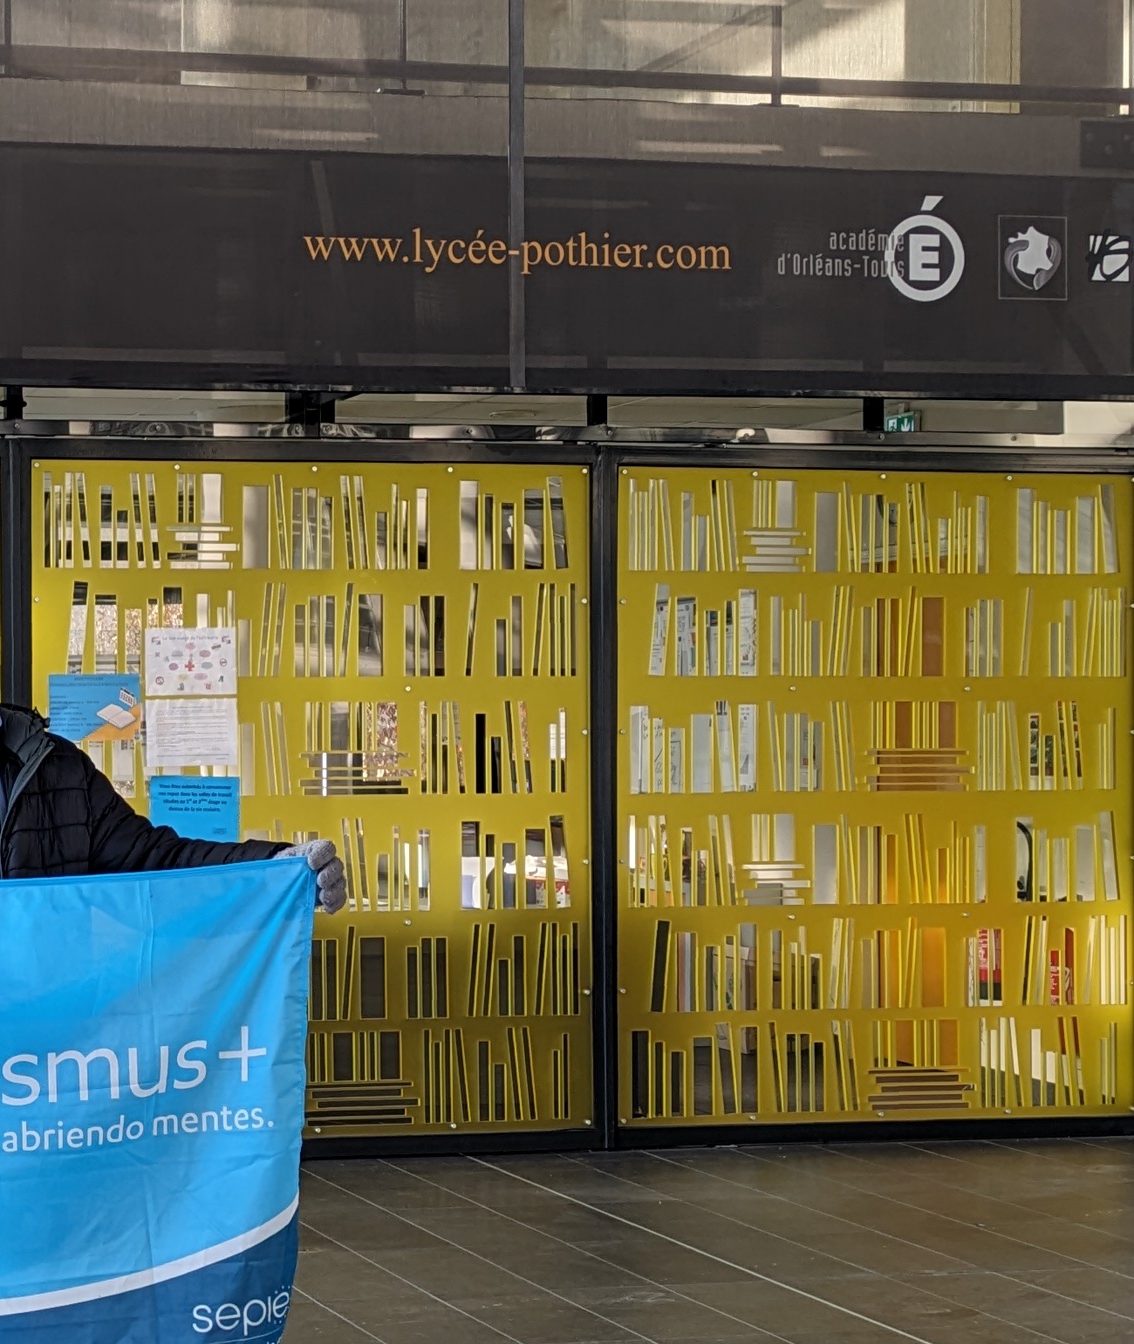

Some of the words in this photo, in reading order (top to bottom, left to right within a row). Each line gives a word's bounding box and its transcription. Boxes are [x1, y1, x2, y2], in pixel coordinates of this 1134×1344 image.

[304, 227, 733, 275] www.lycée-pothier.com
[1, 1114, 144, 1154] abriendo
[152, 1103, 275, 1137] mentes.
[192, 1291, 290, 1337] sepie
